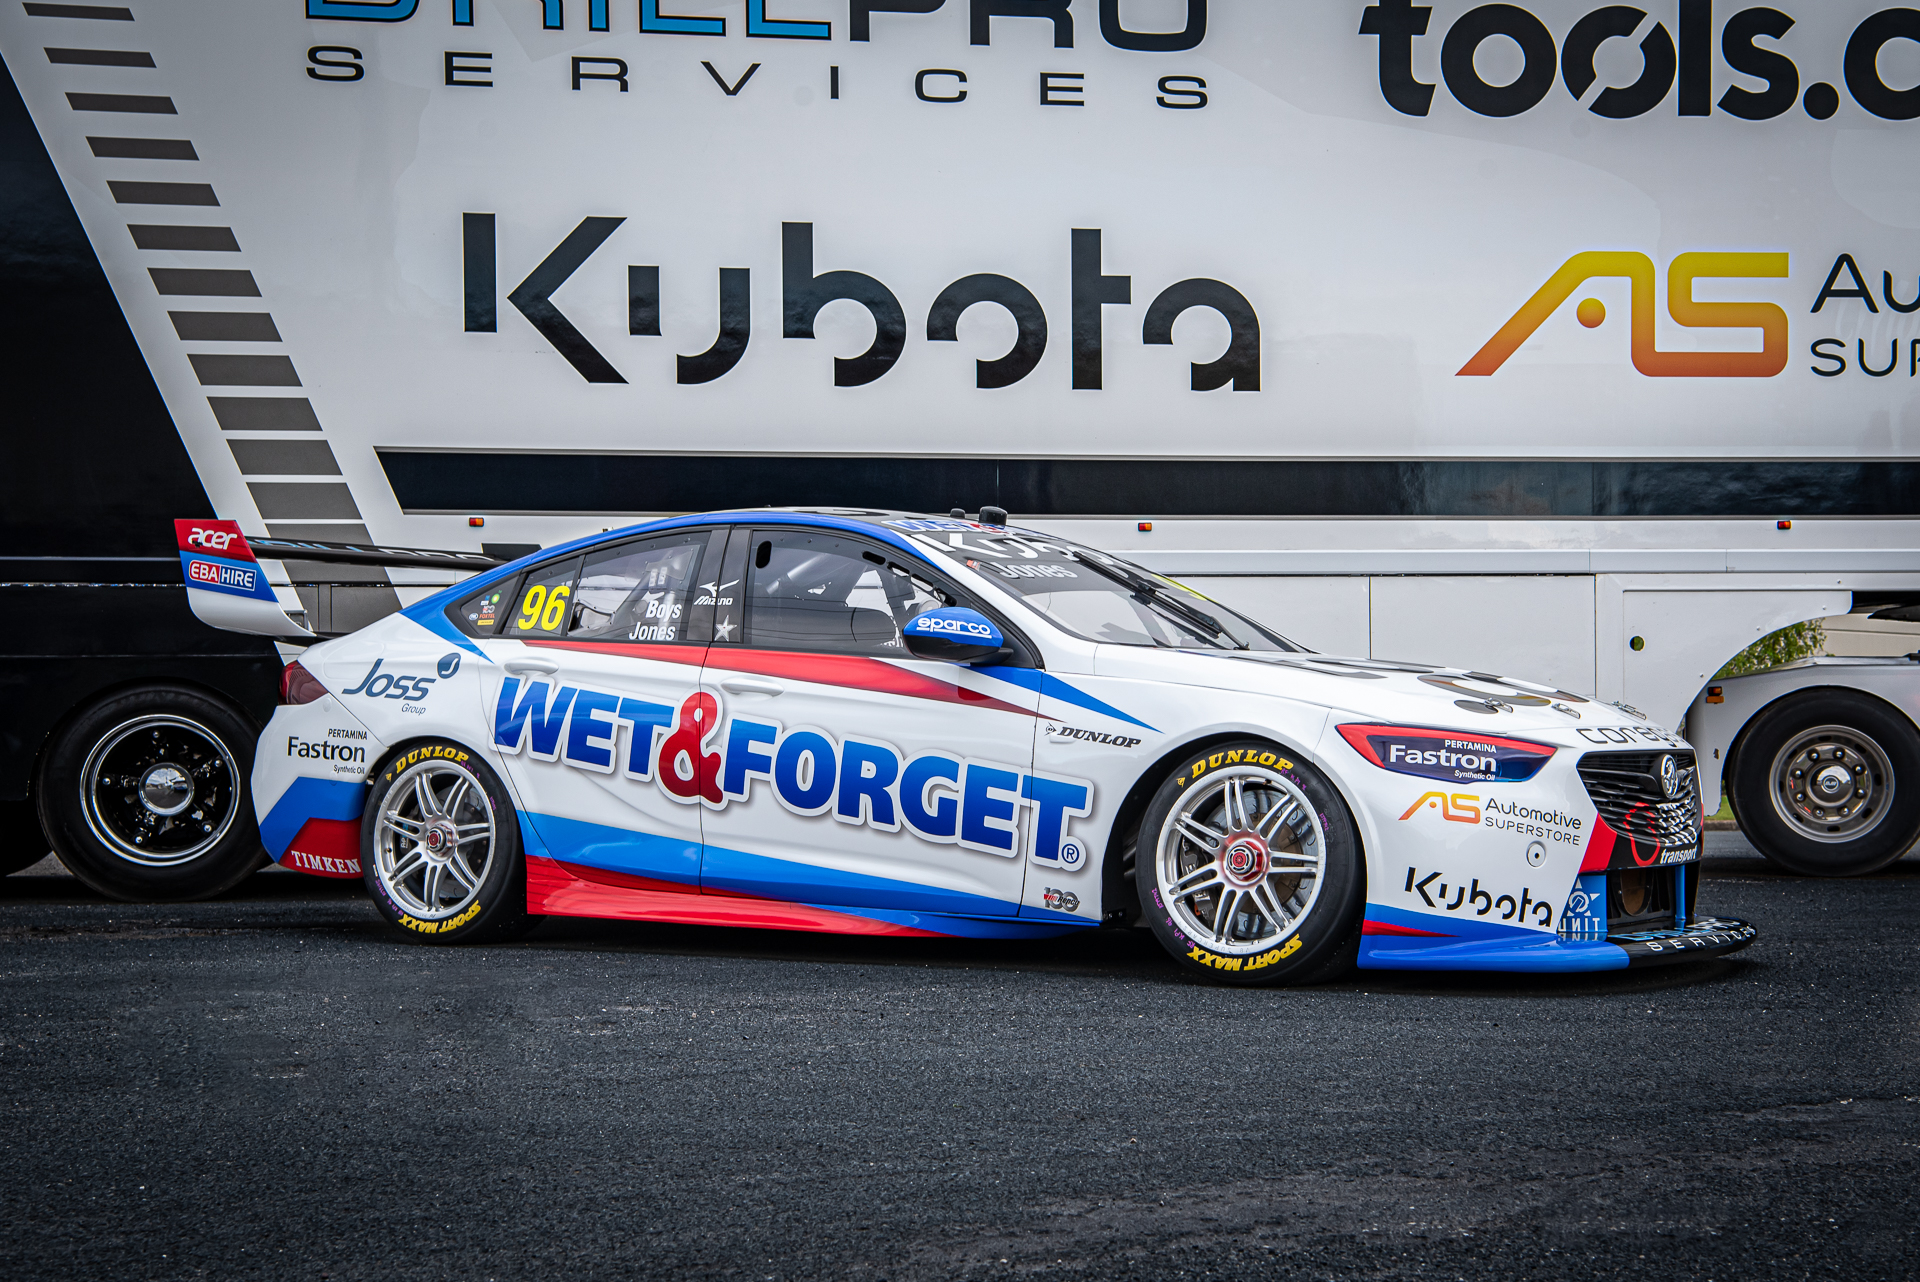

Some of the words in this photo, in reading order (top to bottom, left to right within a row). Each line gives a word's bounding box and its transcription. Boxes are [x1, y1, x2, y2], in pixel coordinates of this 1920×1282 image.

[306, 45, 1208, 110] SERVICES
[463, 212, 1261, 392] Kubota
[1455, 251, 1789, 377] AS
[1810, 338, 1920, 378] SU
[187, 527, 238, 550] acer
[191, 563, 218, 581] EBA
[221, 568, 253, 587] HIRE
[990, 561, 1078, 579] Jones
[518, 585, 570, 631] 96
[645, 600, 682, 622] Boys
[628, 622, 676, 640] Jones
[917, 617, 991, 635] sparco
[341, 658, 436, 701] Joss
[401, 703, 426, 716] Group
[327, 728, 367, 740] PERTAMINA
[1057, 726, 1142, 748] DUNLOP
[1444, 739, 1497, 753] PERTAMINA
[287, 736, 365, 763] Fastron
[396, 746, 469, 773] DUNLOP
[1389, 744, 1497, 772] Fastron
[333, 764, 356, 774] Synthetic
[357, 766, 365, 774] Oil
[1192, 750, 1294, 779] DUNLOP
[1454, 770, 1485, 779] Synthetic
[1486, 773, 1496, 781] Oil
[1398, 791, 1480, 824] AS
[1485, 798, 1582, 830] Automotive
[1485, 817, 1581, 846] SUPERSTORE
[290, 850, 361, 873] TIMKEN
[1660, 845, 1698, 865] transport
[1404, 866, 1554, 928] Kubota
[398, 914, 439, 933] MAXX
[439, 900, 481, 933] SPORT
[1187, 946, 1242, 971] MAXX
[1244, 934, 1303, 971] SPORT
